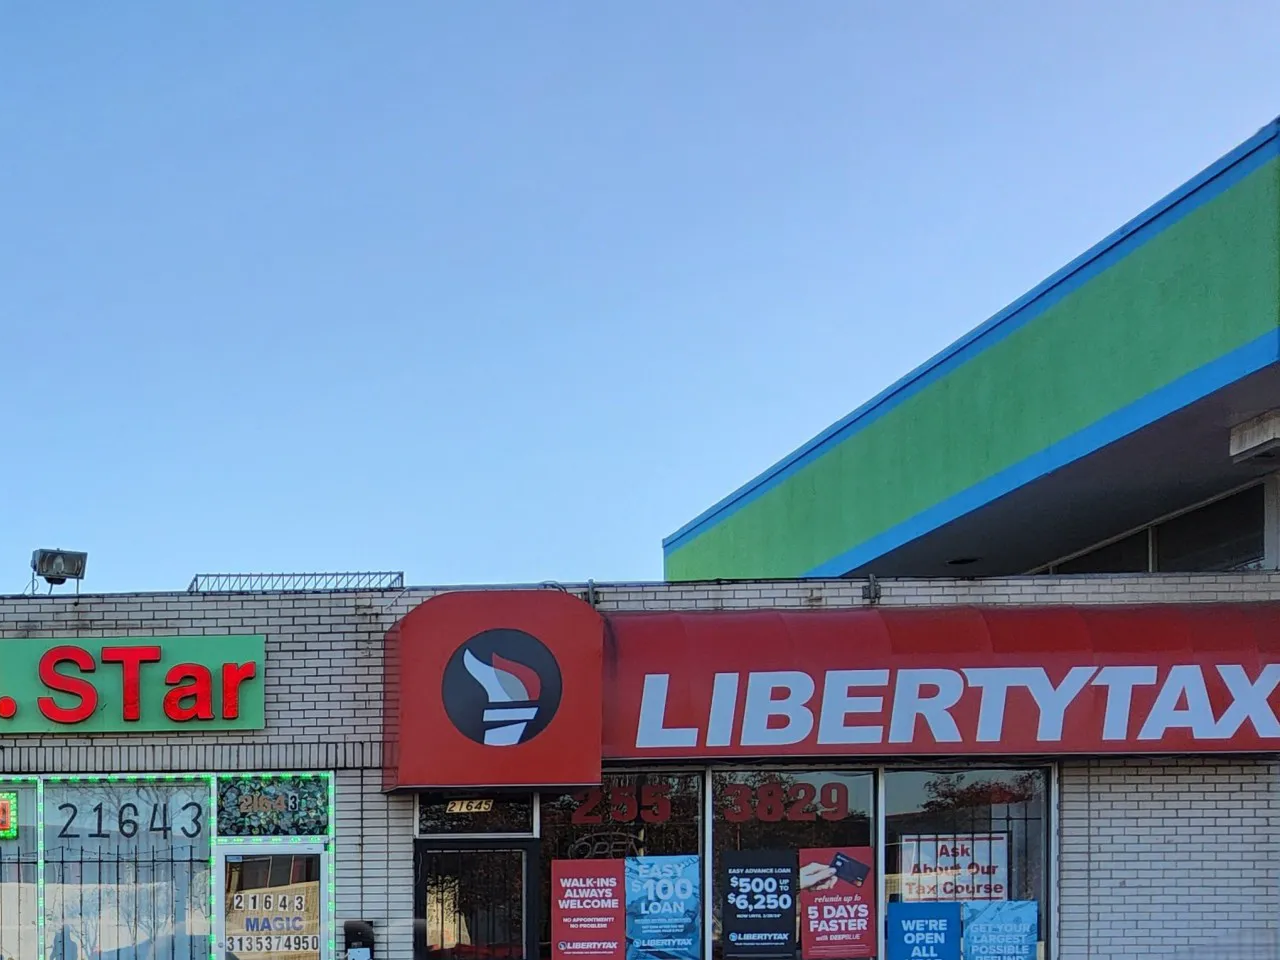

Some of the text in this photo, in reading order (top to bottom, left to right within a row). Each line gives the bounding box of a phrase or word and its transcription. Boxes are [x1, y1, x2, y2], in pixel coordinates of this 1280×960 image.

[238, 794, 299, 812] 21643
[447, 800, 492, 812] 21645
[571, 782, 849, 824] 255 3829
[58, 802, 204, 839] 21643
[939, 844, 971, 857] Ask
[639, 864, 685, 877] EASY
[911, 862, 999, 876] About Our
[559, 877, 617, 888] WALK-INS
[730, 876, 778, 893] $500
[905, 881, 1004, 894] Tax Course
[564, 888, 613, 898] ALWAYS
[632, 879, 693, 900] $100
[234, 894, 305, 910] 21643
[558, 899, 619, 909] WELCOME
[727, 893, 792, 912] $6,250
[814, 895, 842, 903] refunds
[640, 902, 685, 914] LOAN
[807, 904, 869, 919] 5 DAYS
[245, 916, 304, 932] MAGIC
[809, 919, 868, 932] FASTER
[901, 919, 948, 931] WE'RE
[971, 924, 1031, 933] GET YOUR
[227, 935, 319, 951] 3135374950
[903, 932, 945, 944] OPEN
[973, 934, 1028, 944] LARGEST
[911, 946, 938, 957] ALL
[971, 945, 1030, 955] POSSIBLE
